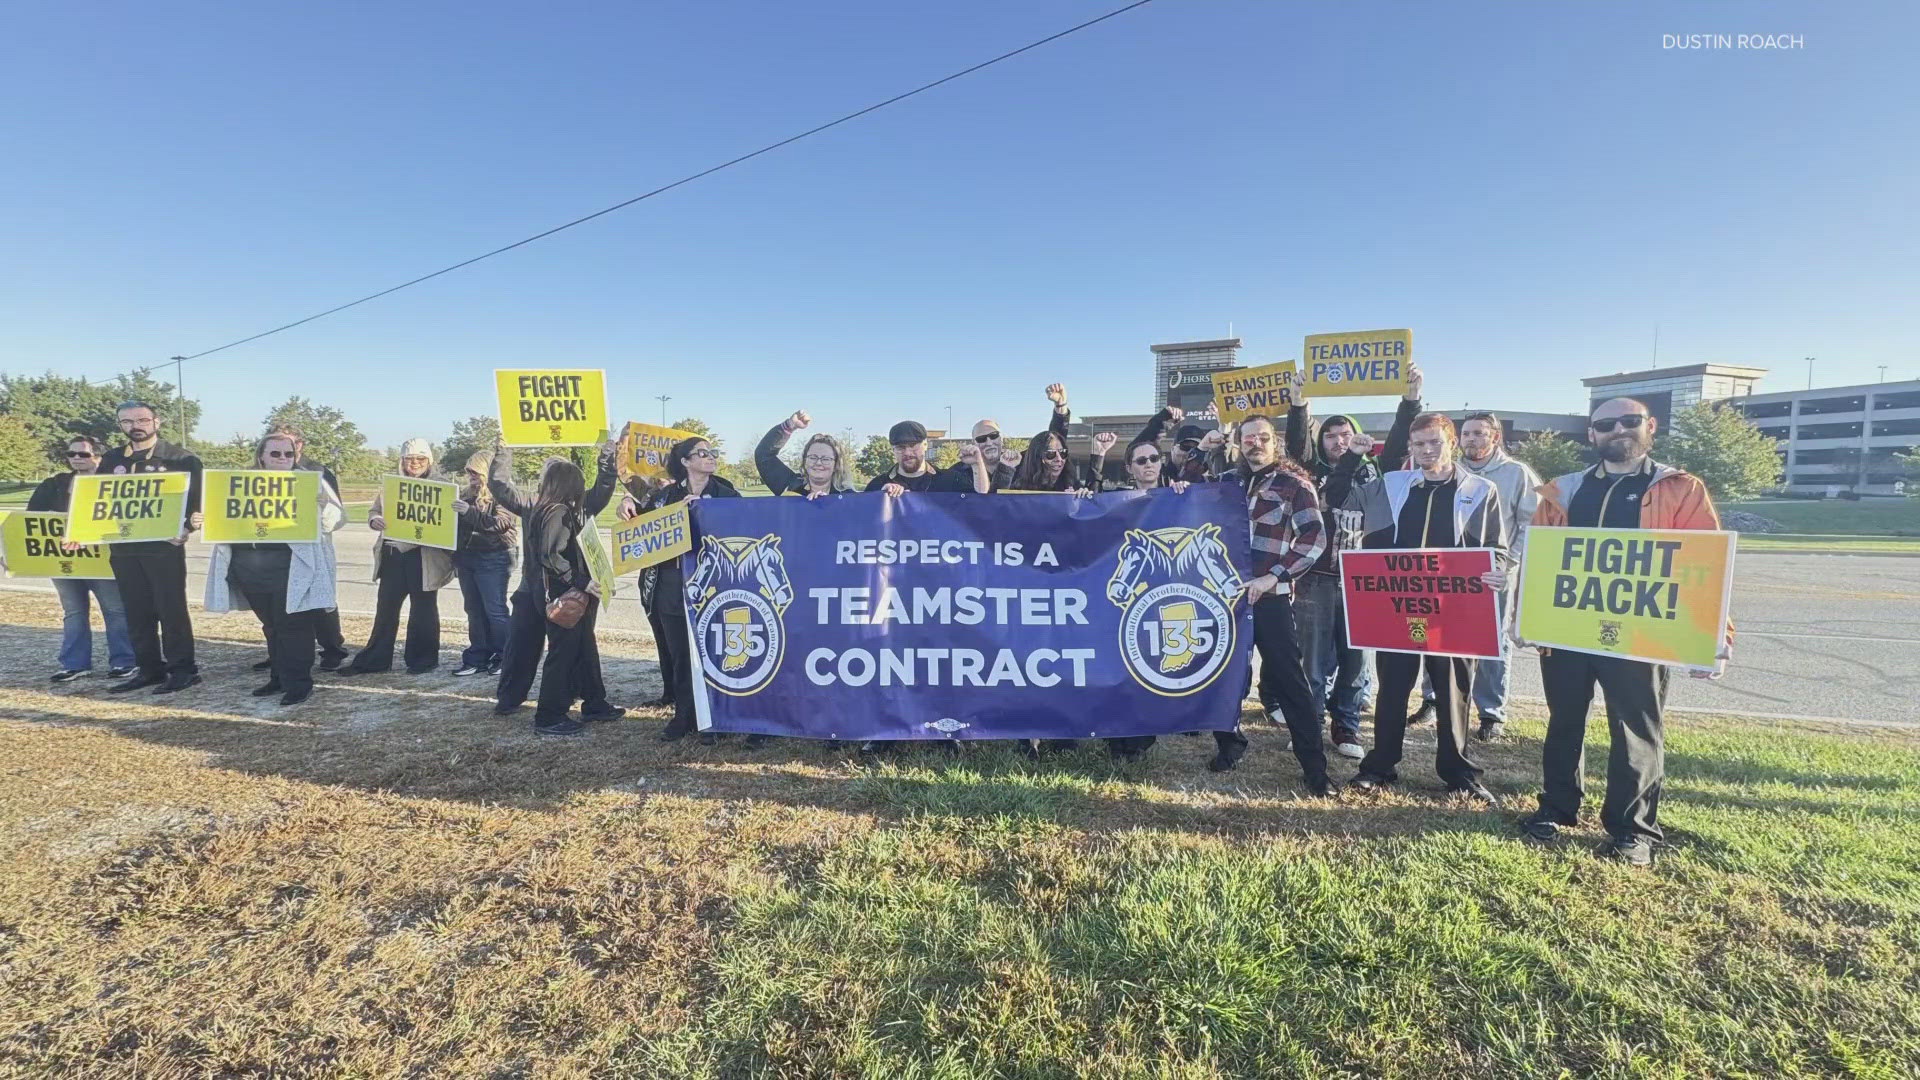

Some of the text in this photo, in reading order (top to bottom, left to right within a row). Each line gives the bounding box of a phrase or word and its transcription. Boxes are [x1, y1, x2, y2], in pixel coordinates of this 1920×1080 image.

[1310, 340, 1405, 361] TEAMSTER
[519, 375, 582, 397] FIGHT
[1183, 374, 1211, 384] HORS
[1217, 371, 1291, 394] TEAMSTER
[519, 400, 586, 422] BACK!
[98, 479, 166, 500] FIGHT
[230, 476, 296, 497] FIGHT
[399, 482, 442, 506] FIGHT
[92, 499, 163, 521] BACK!
[226, 498, 297, 520] BACK!
[396, 502, 442, 526] BACK!
[25, 517, 67, 537] FIG
[616, 510, 684, 543] TEAMSTER
[836, 539, 1059, 566] RESPECT IS A
[1384, 554, 1440, 572] VOTE
[1561, 537, 1682, 578] FIGHT
[1351, 575, 1483, 594] TEAMSTERS
[809, 585, 1089, 625] TEAMSTER
[1390, 596, 1441, 614] YES!
[1553, 574, 1679, 620] BACK!
[716, 591, 763, 608] Brotherhood
[761, 606, 770, 616] of
[767, 618, 777, 663] Teamsters
[1129, 585, 1227, 661] International Brotherhood of Teamsters
[711, 623, 765, 657] 135
[1143, 619, 1214, 656] 135
[805, 647, 1096, 688] CONTRACT
